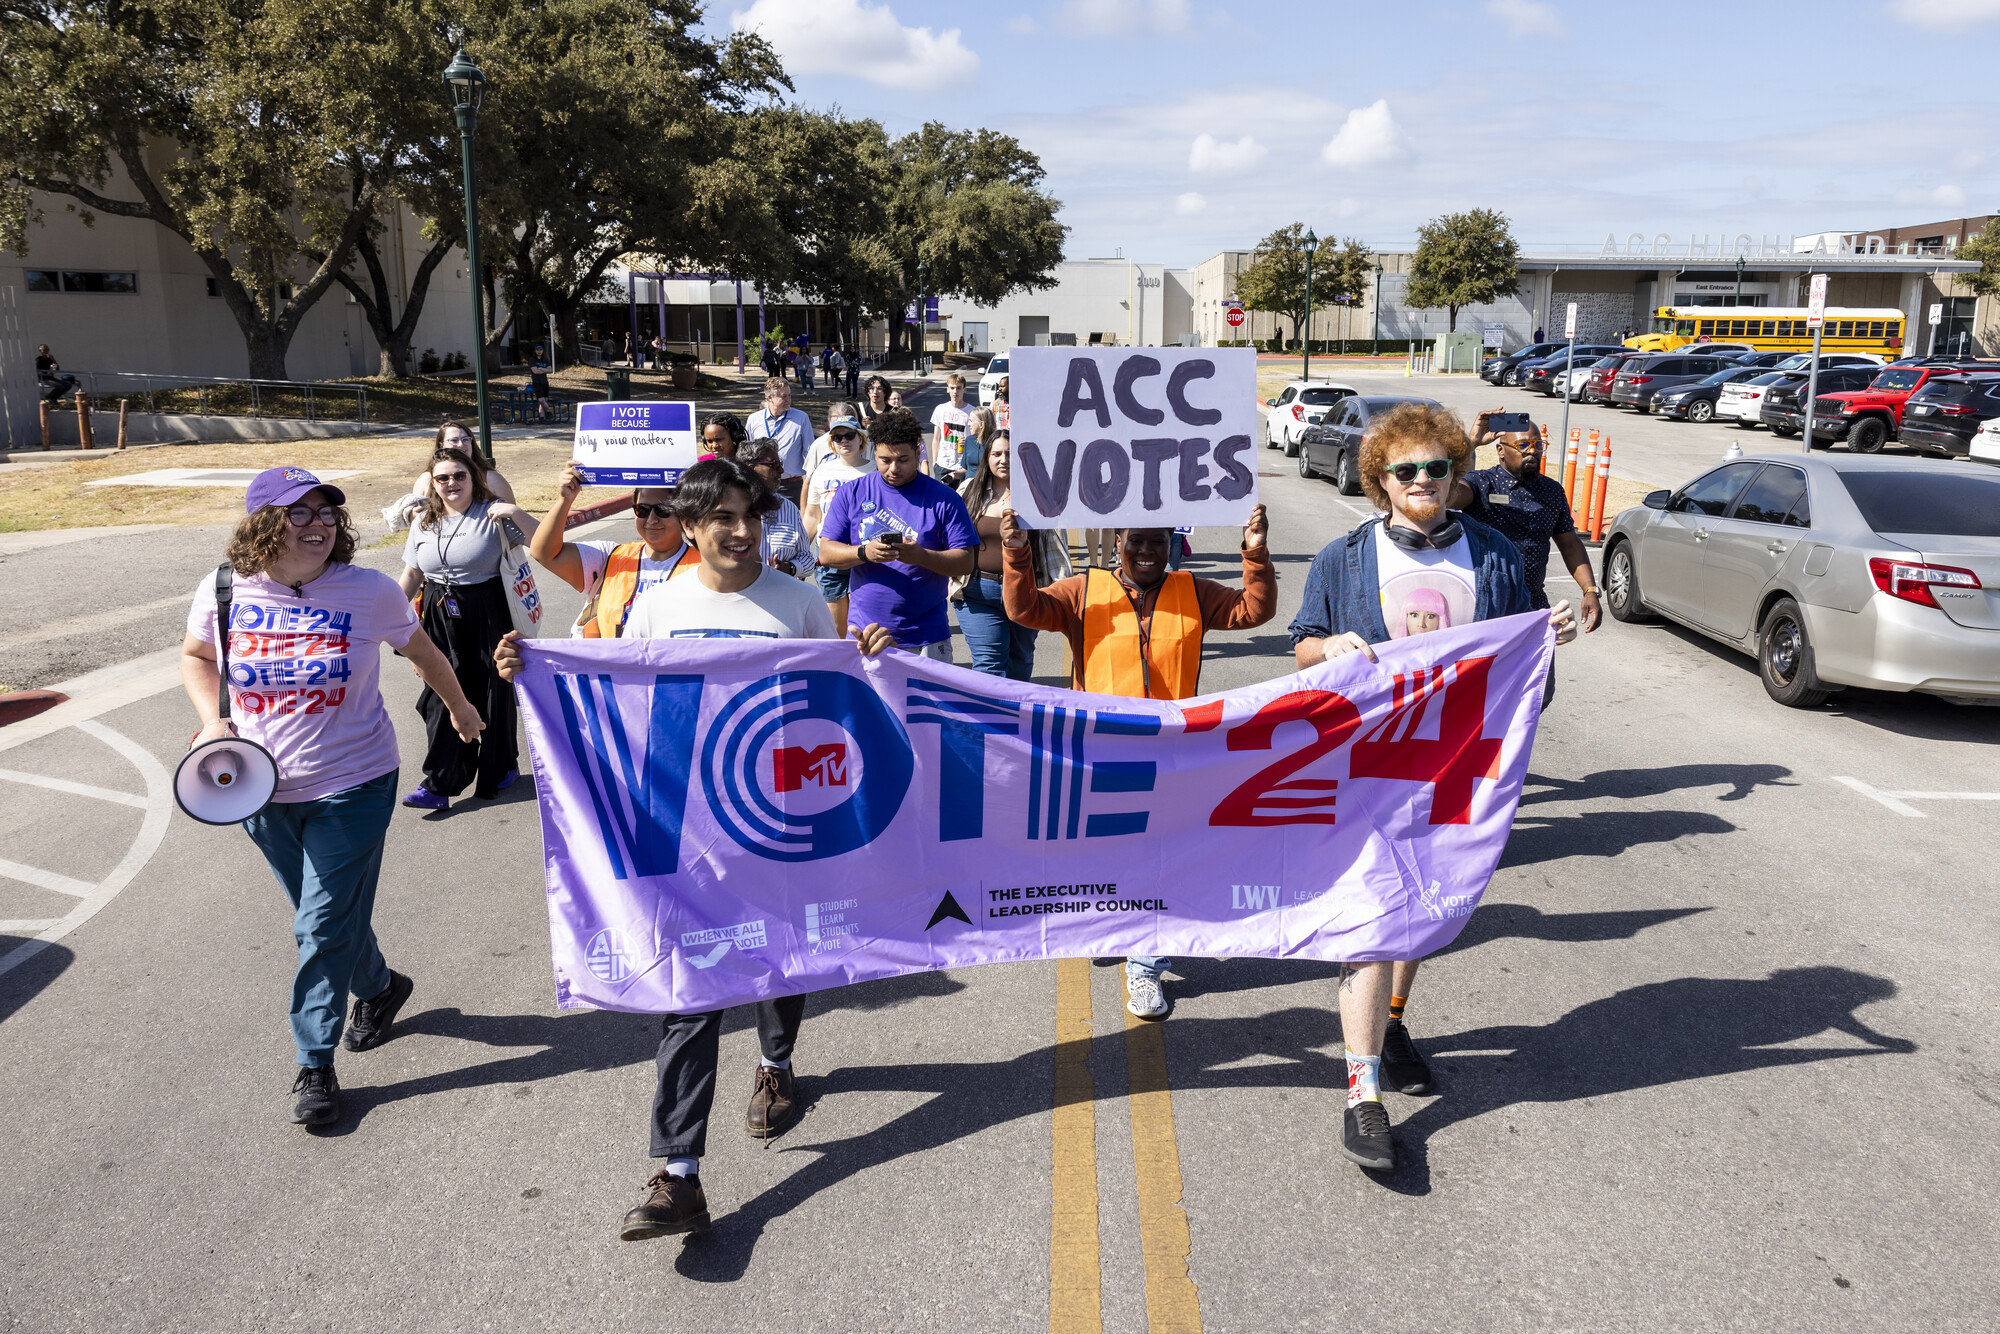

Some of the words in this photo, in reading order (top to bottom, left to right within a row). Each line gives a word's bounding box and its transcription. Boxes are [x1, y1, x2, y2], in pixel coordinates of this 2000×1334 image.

[1600, 233, 1672, 257] ACC
[1690, 233, 1886, 259] HIGHLAND
[1137, 276, 1160, 288] 2000
[1227, 313, 1244, 321] STOP
[1057, 354, 1223, 428] ACC
[612, 408, 616, 417] I
[619, 408, 650, 418] VOTE
[611, 420, 651, 428] BECAUSE:
[604, 435, 628, 446] voice
[1018, 434, 1254, 518] VOTES
[875, 508, 890, 522] ACC
[1940, 592, 1976, 600] CAMRY
[228, 658, 352, 687] OTE'24
[773, 743, 847, 793] MTV
[989, 888, 1021, 902] THE
[1025, 883, 1117, 899] EXECUTIVE
[1231, 884, 1282, 910] LWV
[820, 899, 858, 913] STUDENTS
[989, 901, 1091, 918] LEADERSHIP
[1095, 899, 1169, 912] COUNCIL
[1440, 895, 1474, 907] VOTE
[821, 913, 844, 926] LEARN
[684, 931, 721, 945] WHEN
[722, 927, 740, 938] WE
[742, 923, 763, 936] ALL
[821, 923, 860, 938] STUDENTS
[592, 929, 636, 956] ALL
[736, 934, 765, 949] VOTE
[822, 938, 841, 951] VOTE
